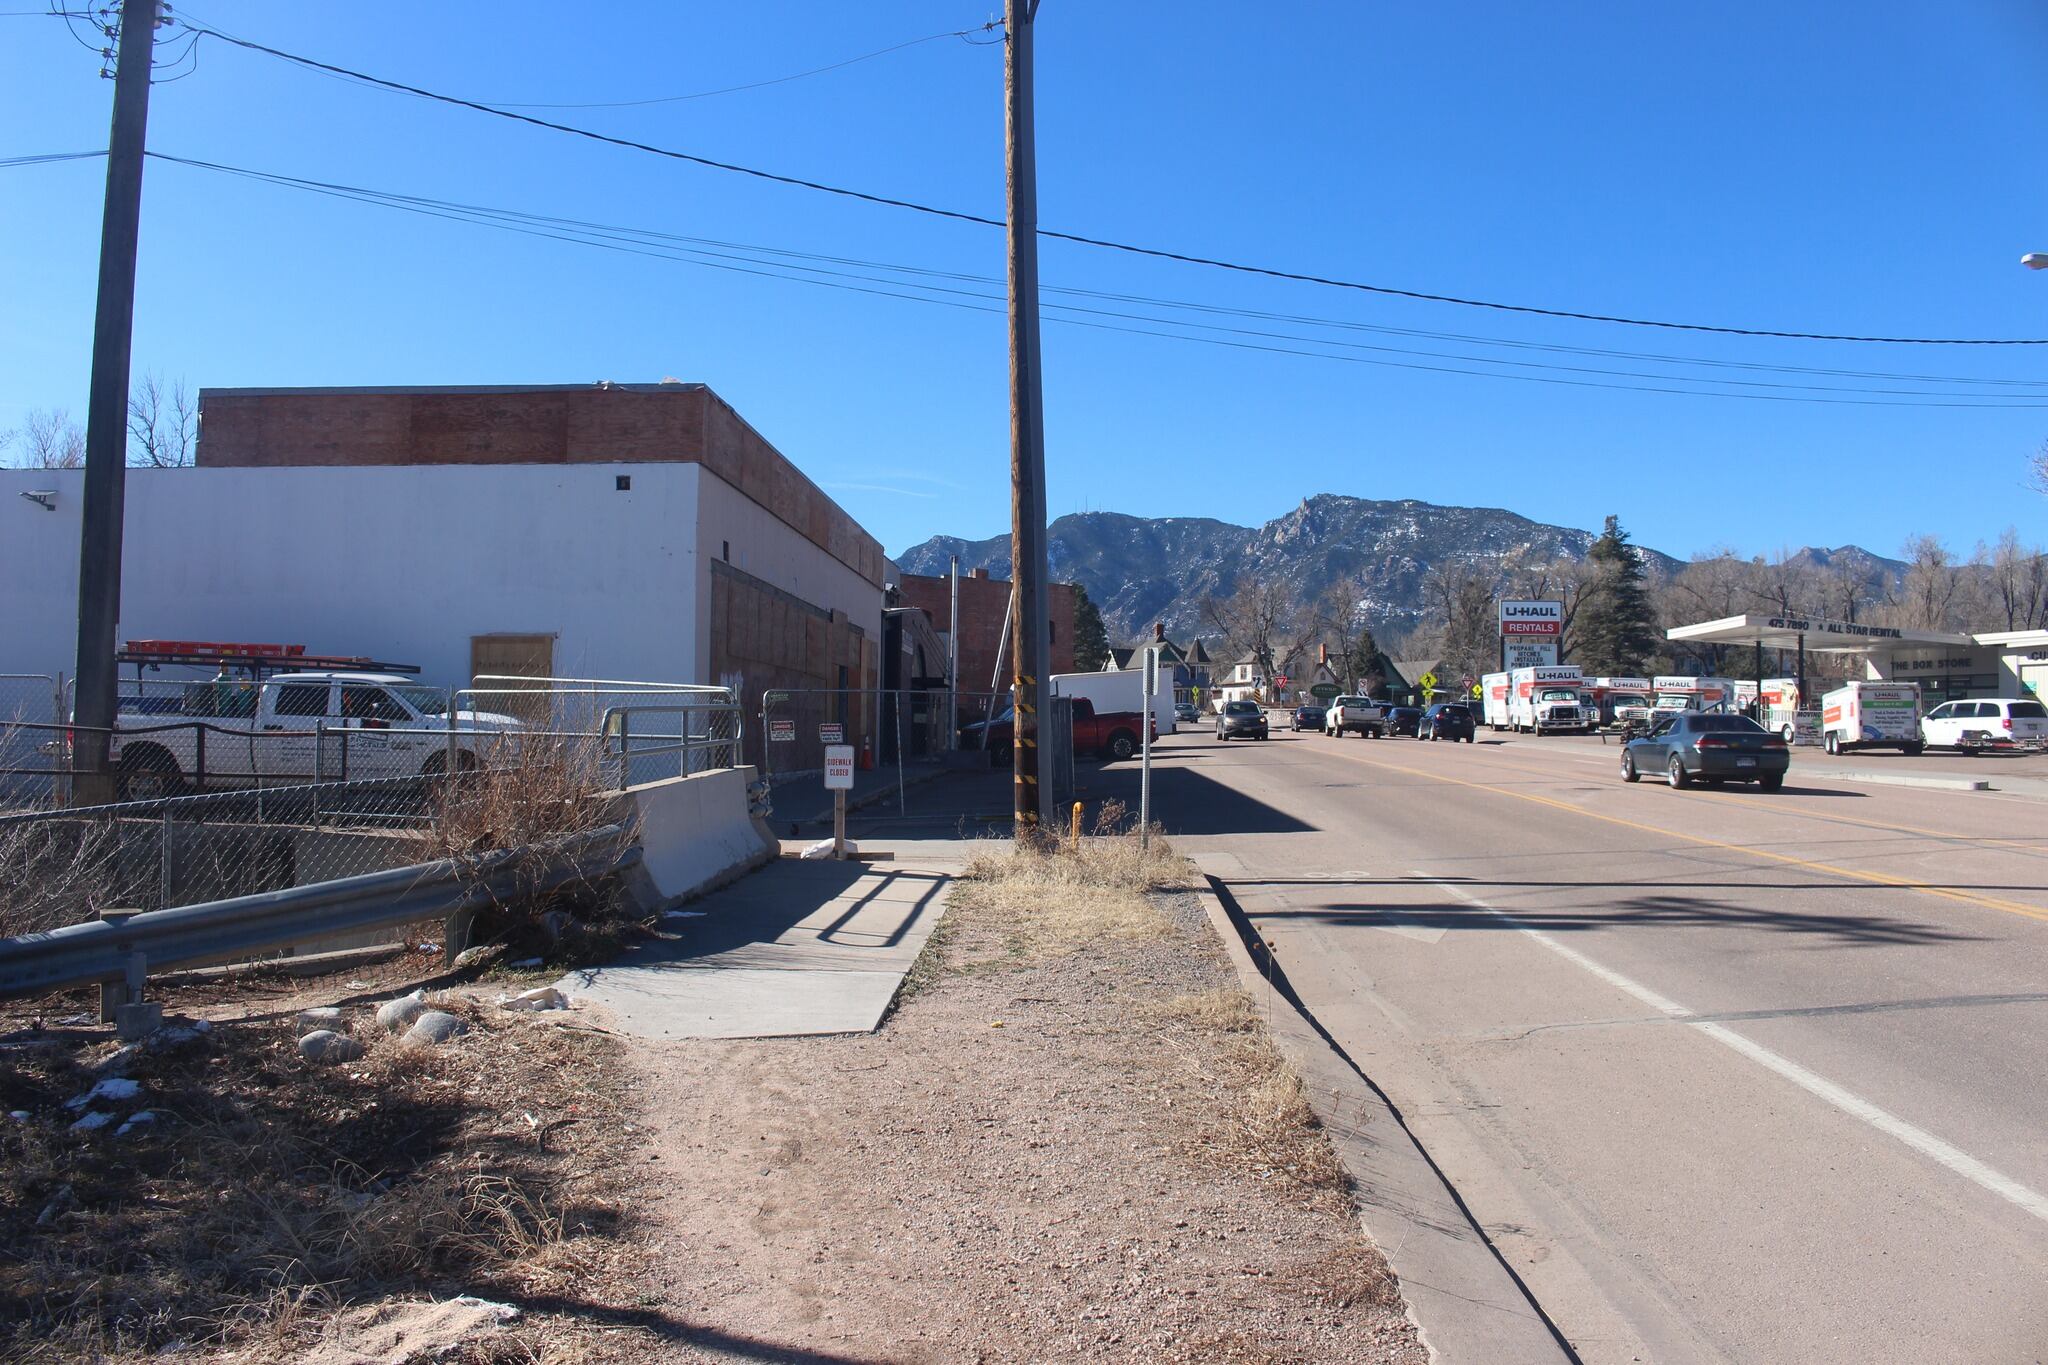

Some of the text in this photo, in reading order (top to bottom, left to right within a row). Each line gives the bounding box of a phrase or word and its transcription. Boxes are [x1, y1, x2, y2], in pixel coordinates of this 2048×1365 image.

[1505, 606, 1557, 617] U-HAUL
[1509, 623, 1554, 632] RENTALS
[1768, 618, 1785, 629] 475
[1828, 623, 1903, 639] ALL STAR RENTAL
[2031, 651, 2048, 661] CU
[1891, 658, 1972, 671] THE BOX STORE
[1537, 672, 1578, 680] U-HAUL
[827, 758, 852, 766] SIDEWALK
[829, 768, 849, 776] CLOSED
